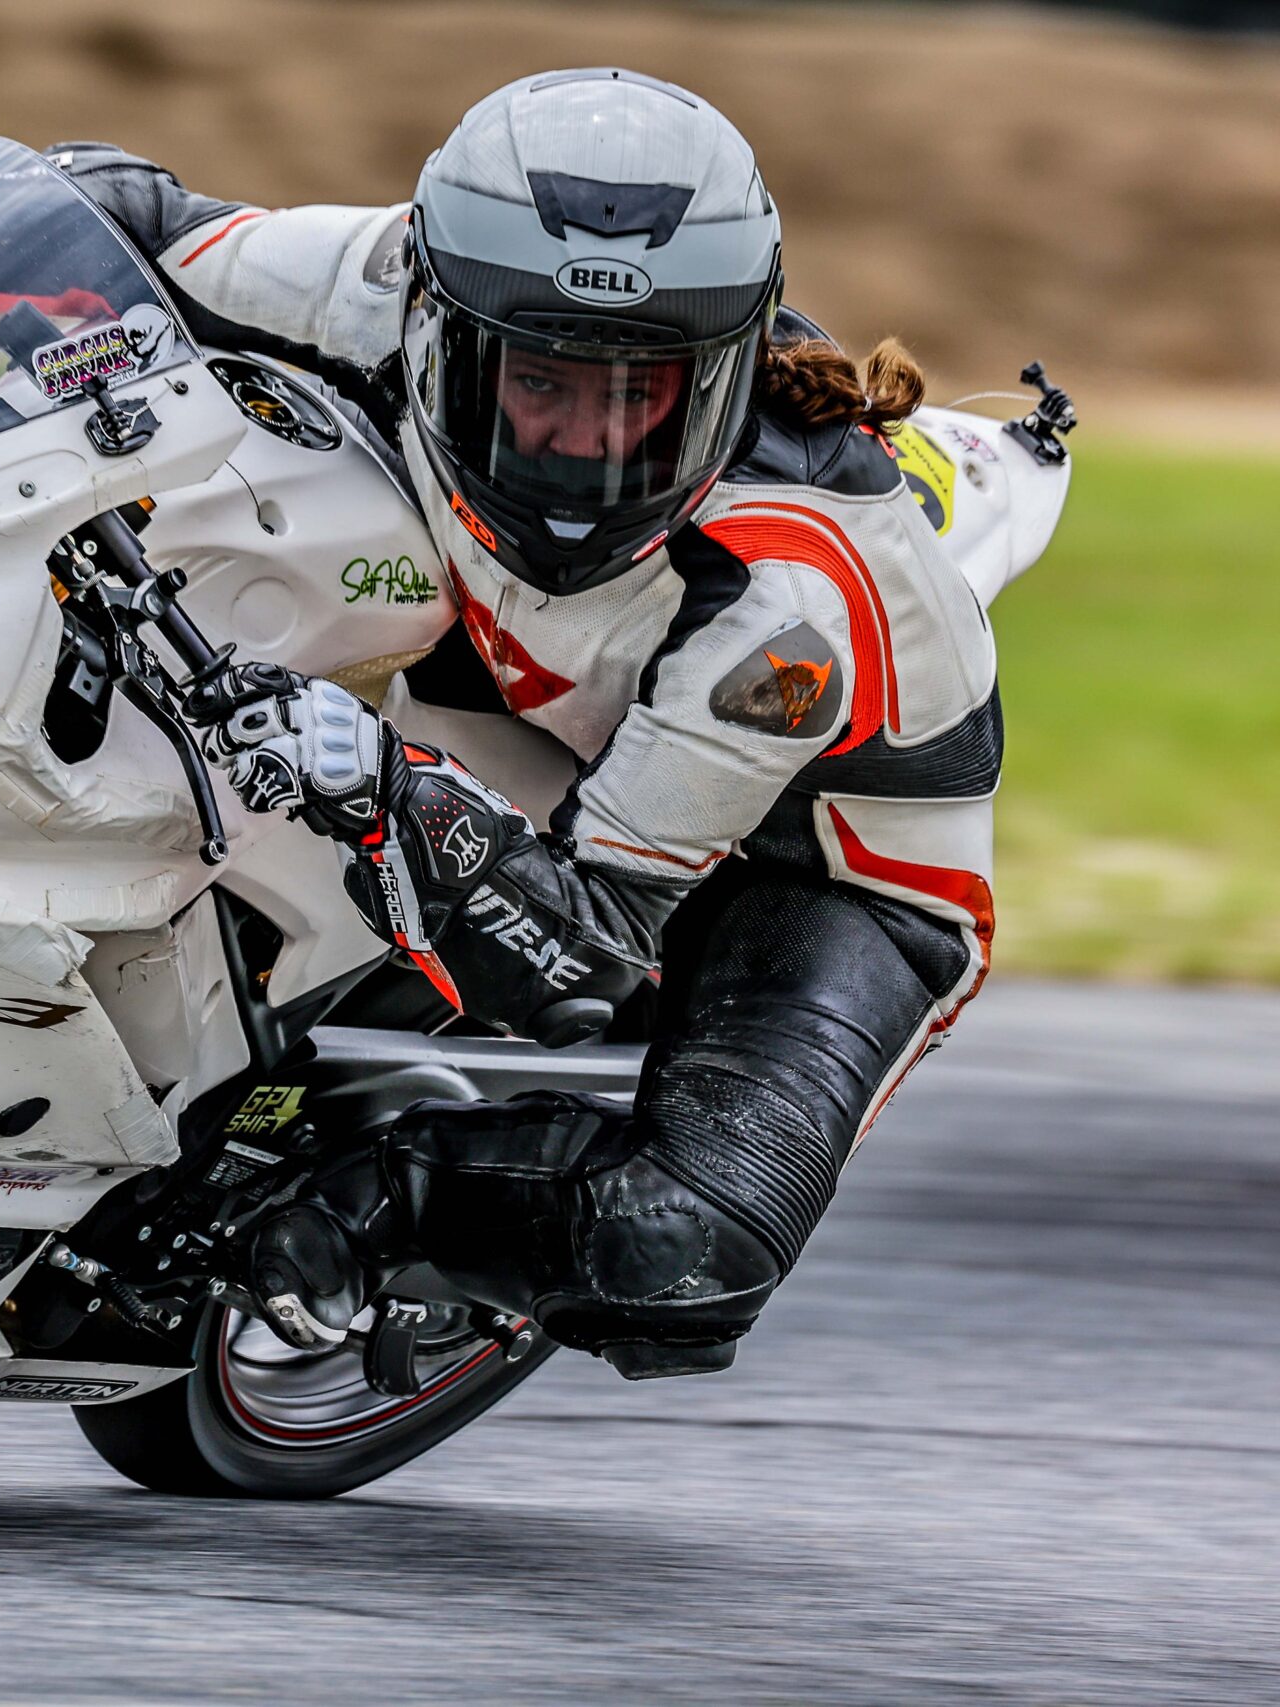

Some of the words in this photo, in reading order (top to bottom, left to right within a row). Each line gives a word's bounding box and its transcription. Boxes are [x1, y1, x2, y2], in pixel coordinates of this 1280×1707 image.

[570, 267, 639, 294] BELL
[37, 327, 126, 374] CIRCUS
[41, 348, 133, 396] FREAK
[375, 861, 407, 934] HEROIC
[238, 1086, 292, 1113] GP
[223, 1114, 288, 1135] SHIFT
